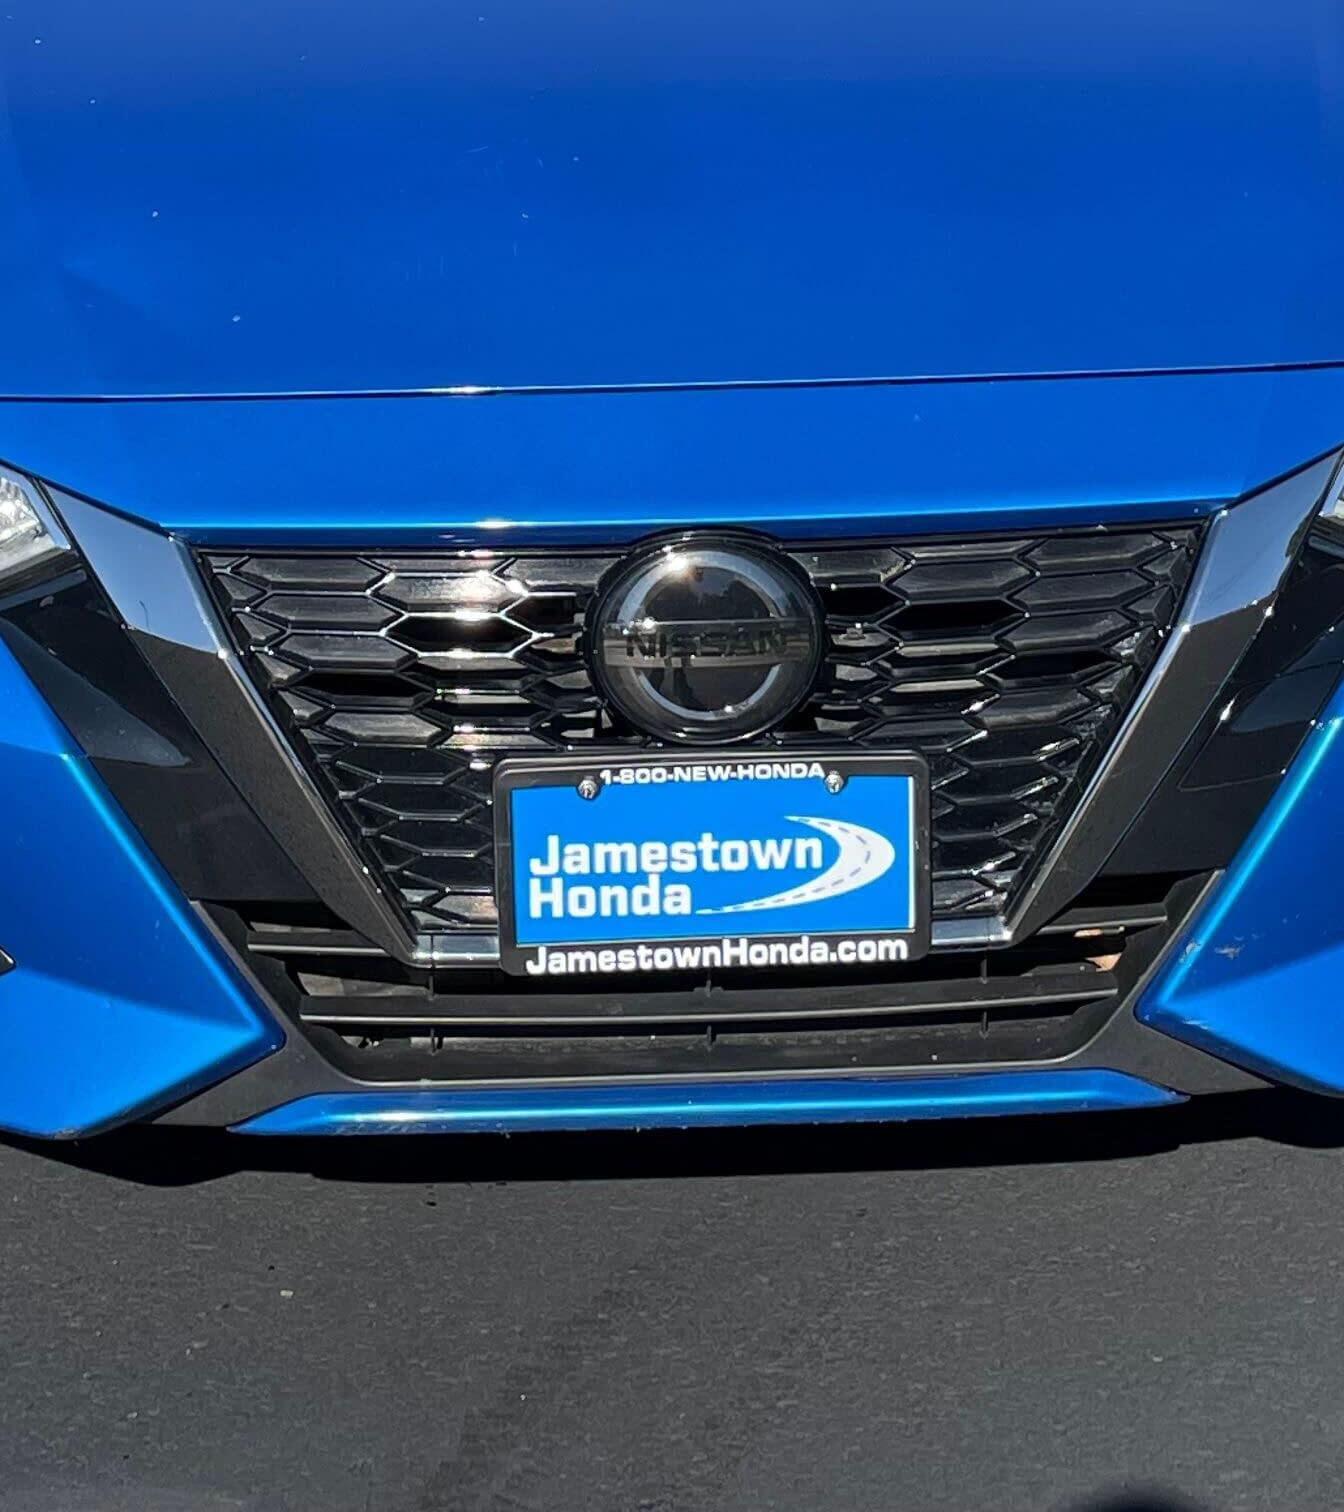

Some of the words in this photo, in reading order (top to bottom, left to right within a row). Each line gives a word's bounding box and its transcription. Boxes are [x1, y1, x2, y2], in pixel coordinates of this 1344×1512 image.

[600, 762, 825, 785] 1-800-NEW-HONDA
[529, 832, 823, 876] Jamestown
[529, 874, 692, 919] Honda
[525, 936, 909, 977] JamestownHonda.com
